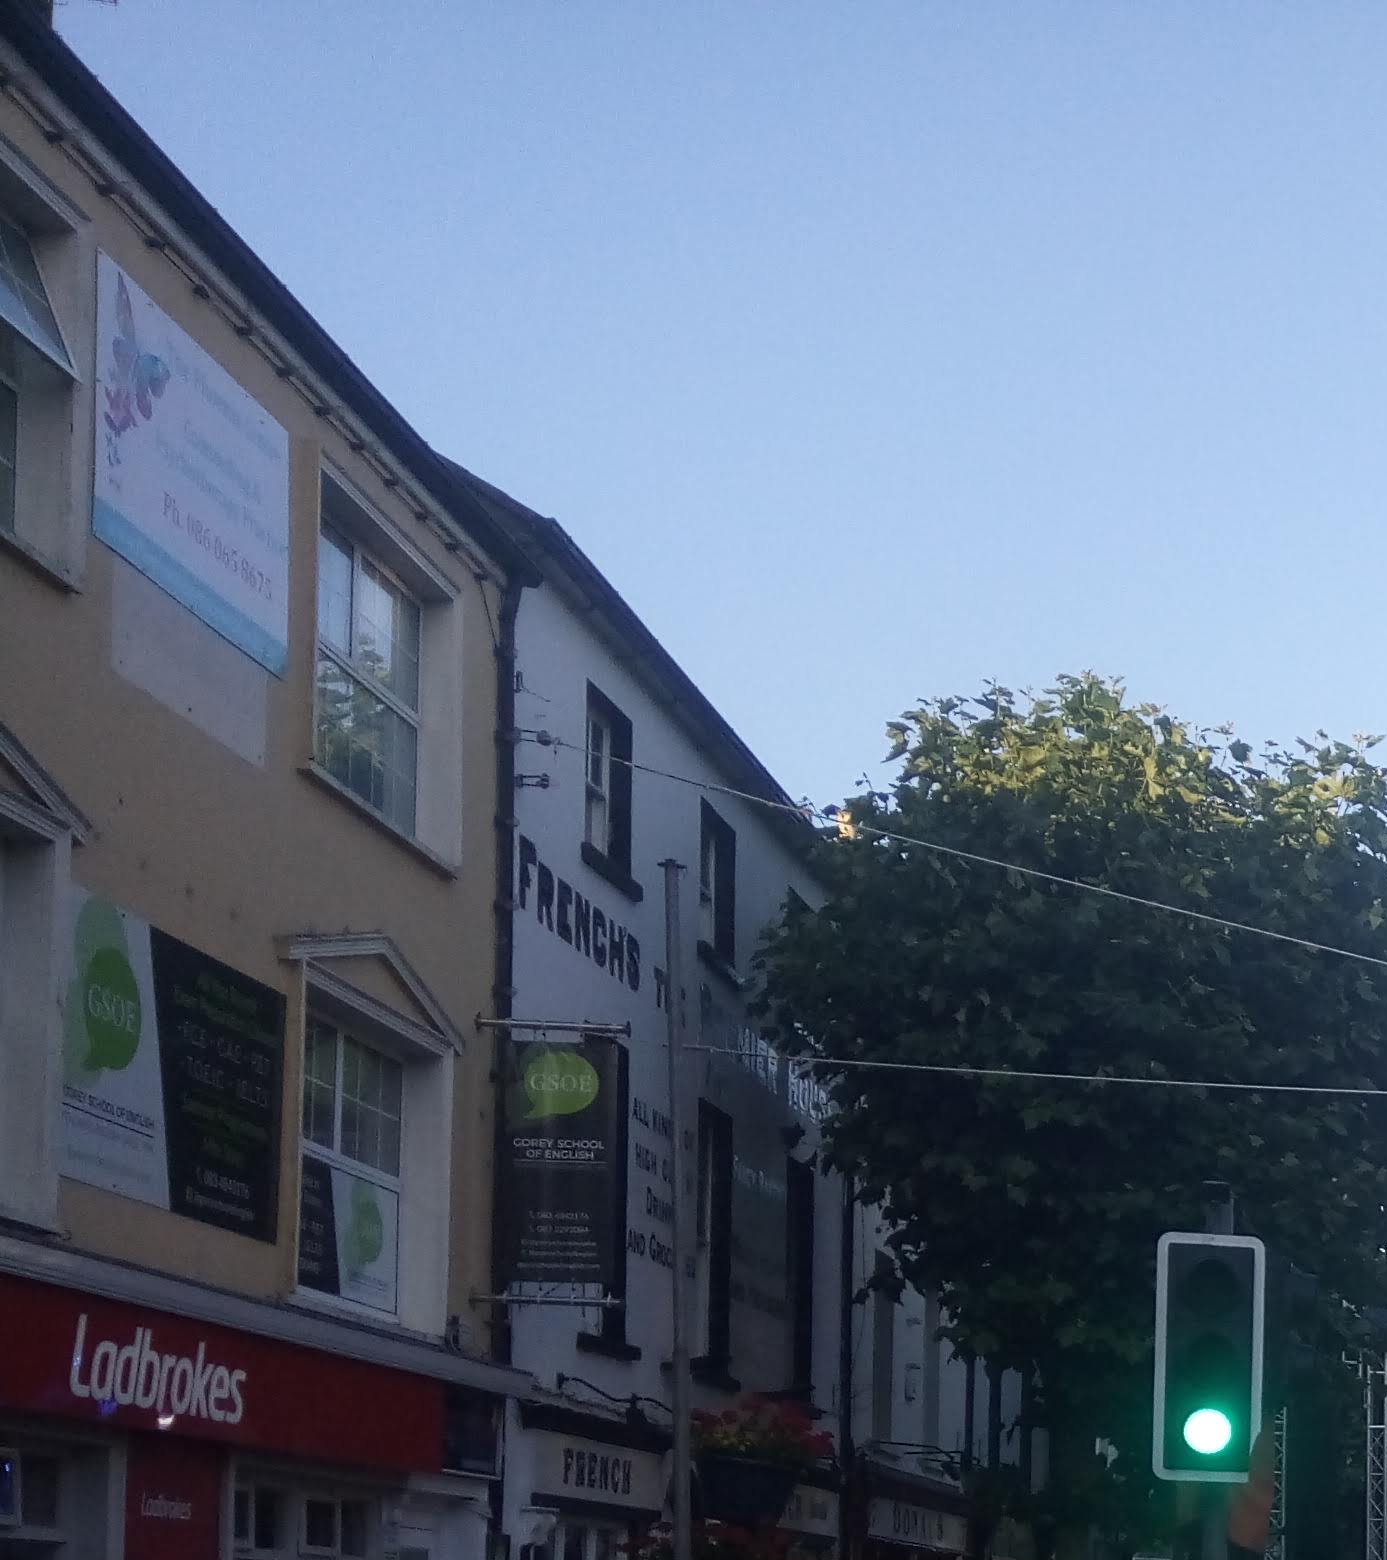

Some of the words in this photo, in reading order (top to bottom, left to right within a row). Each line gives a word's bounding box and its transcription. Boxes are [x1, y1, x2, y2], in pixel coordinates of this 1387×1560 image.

[518, 834, 641, 992] FRENCH'S
[88, 984, 136, 1032] GSOE
[529, 1072, 593, 1092] GSOE
[632, 1098, 650, 1128] ALL
[513, 1138, 553, 1149] GOREY
[557, 1139, 605, 1150] SCHOOL
[526, 1150, 541, 1159] OF
[544, 1150, 595, 1161] ENGLISH
[635, 1142, 657, 1176] HIGH
[626, 1229, 646, 1257] AND
[69, 1313, 247, 1425] Ladbrokes
[562, 1447, 633, 1496] FRENCH
